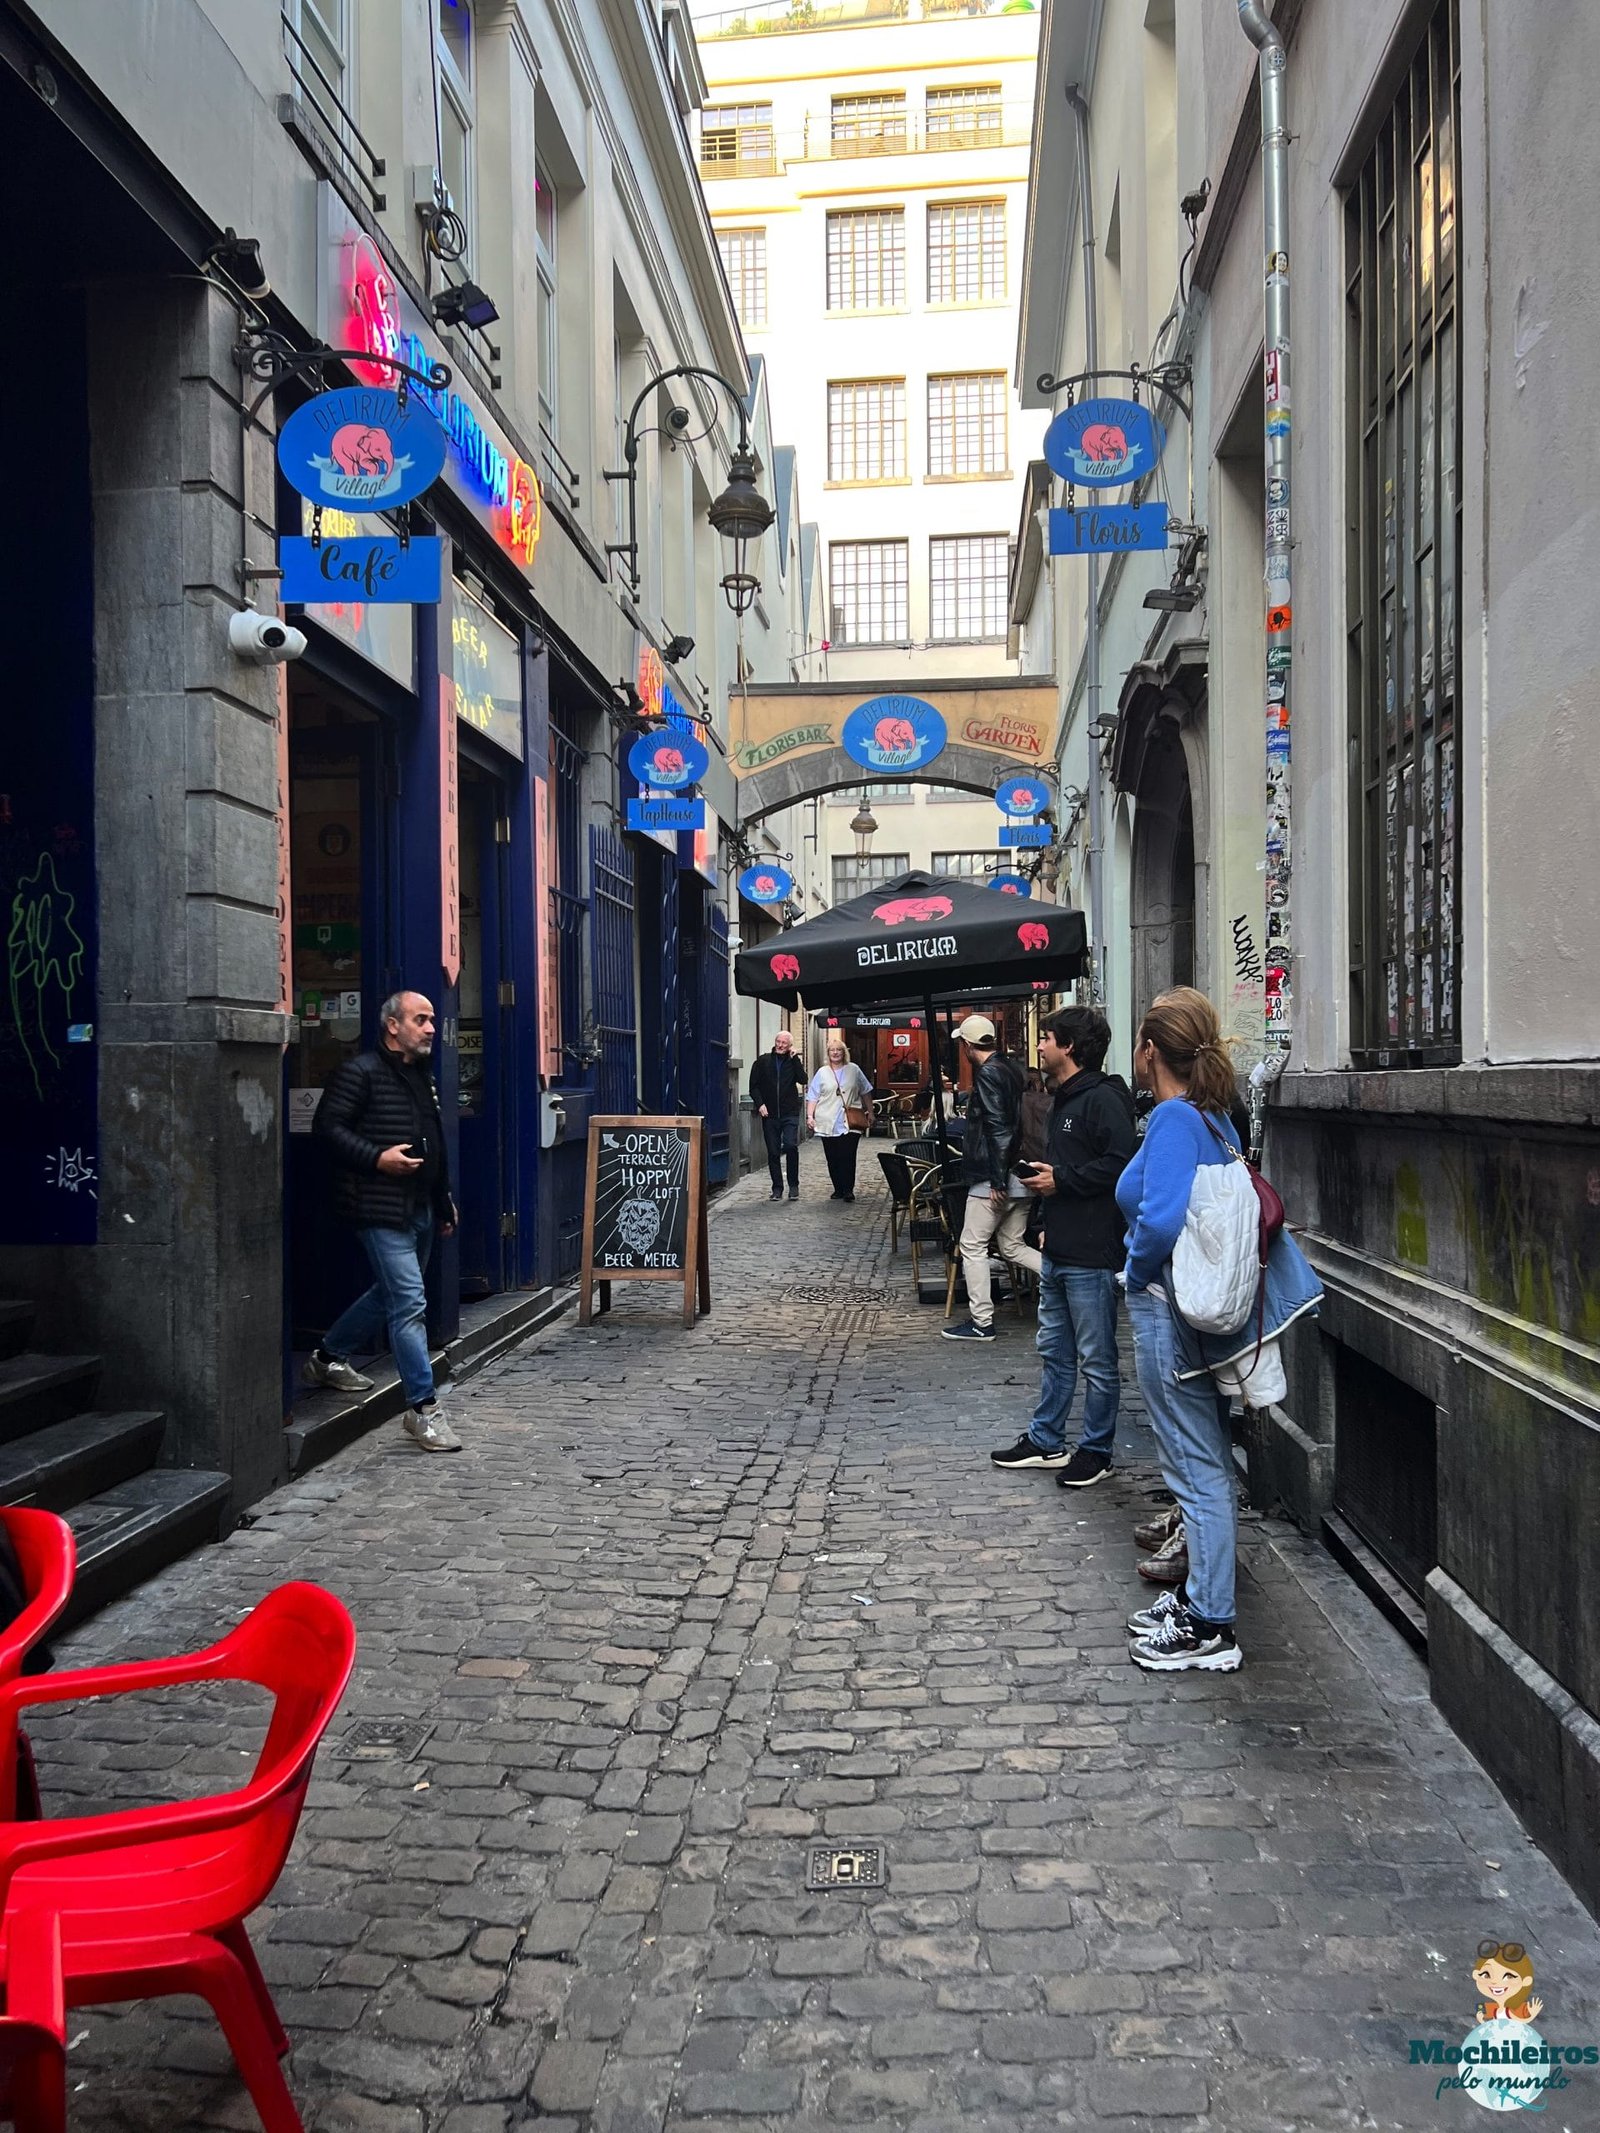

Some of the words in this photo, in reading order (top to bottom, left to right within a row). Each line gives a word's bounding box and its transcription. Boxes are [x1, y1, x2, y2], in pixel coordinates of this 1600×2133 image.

[313, 394, 410, 434] DELIRIUM
[1067, 402, 1139, 432] DELIRIUM
[1085, 460, 1123, 482] Village
[335, 477, 387, 504] Village
[1072, 511, 1145, 549] Floris
[320, 544, 400, 597] Café
[862, 698, 927, 723] DELIRIUM
[966, 719, 1043, 753] GARDEN
[1001, 715, 1038, 735] FLORIS
[644, 731, 692, 751] DELIRIUM
[745, 731, 797, 766] FLORIS
[797, 726, 824, 744] BAR
[878, 750, 912, 767] Village
[638, 802, 696, 828] TapHouse
[1009, 827, 1040, 844] Floris
[856, 935, 958, 967] DELIRIUM
[856, 1017, 891, 1026] DELIRIUM
[625, 1133, 670, 1153] OPEN
[617, 1154, 668, 1166] TERRACE
[621, 1168, 672, 1187] HOPPY
[654, 1186, 681, 1200] LOFT
[604, 1253, 634, 1268] BEER
[643, 1252, 680, 1268] METER
